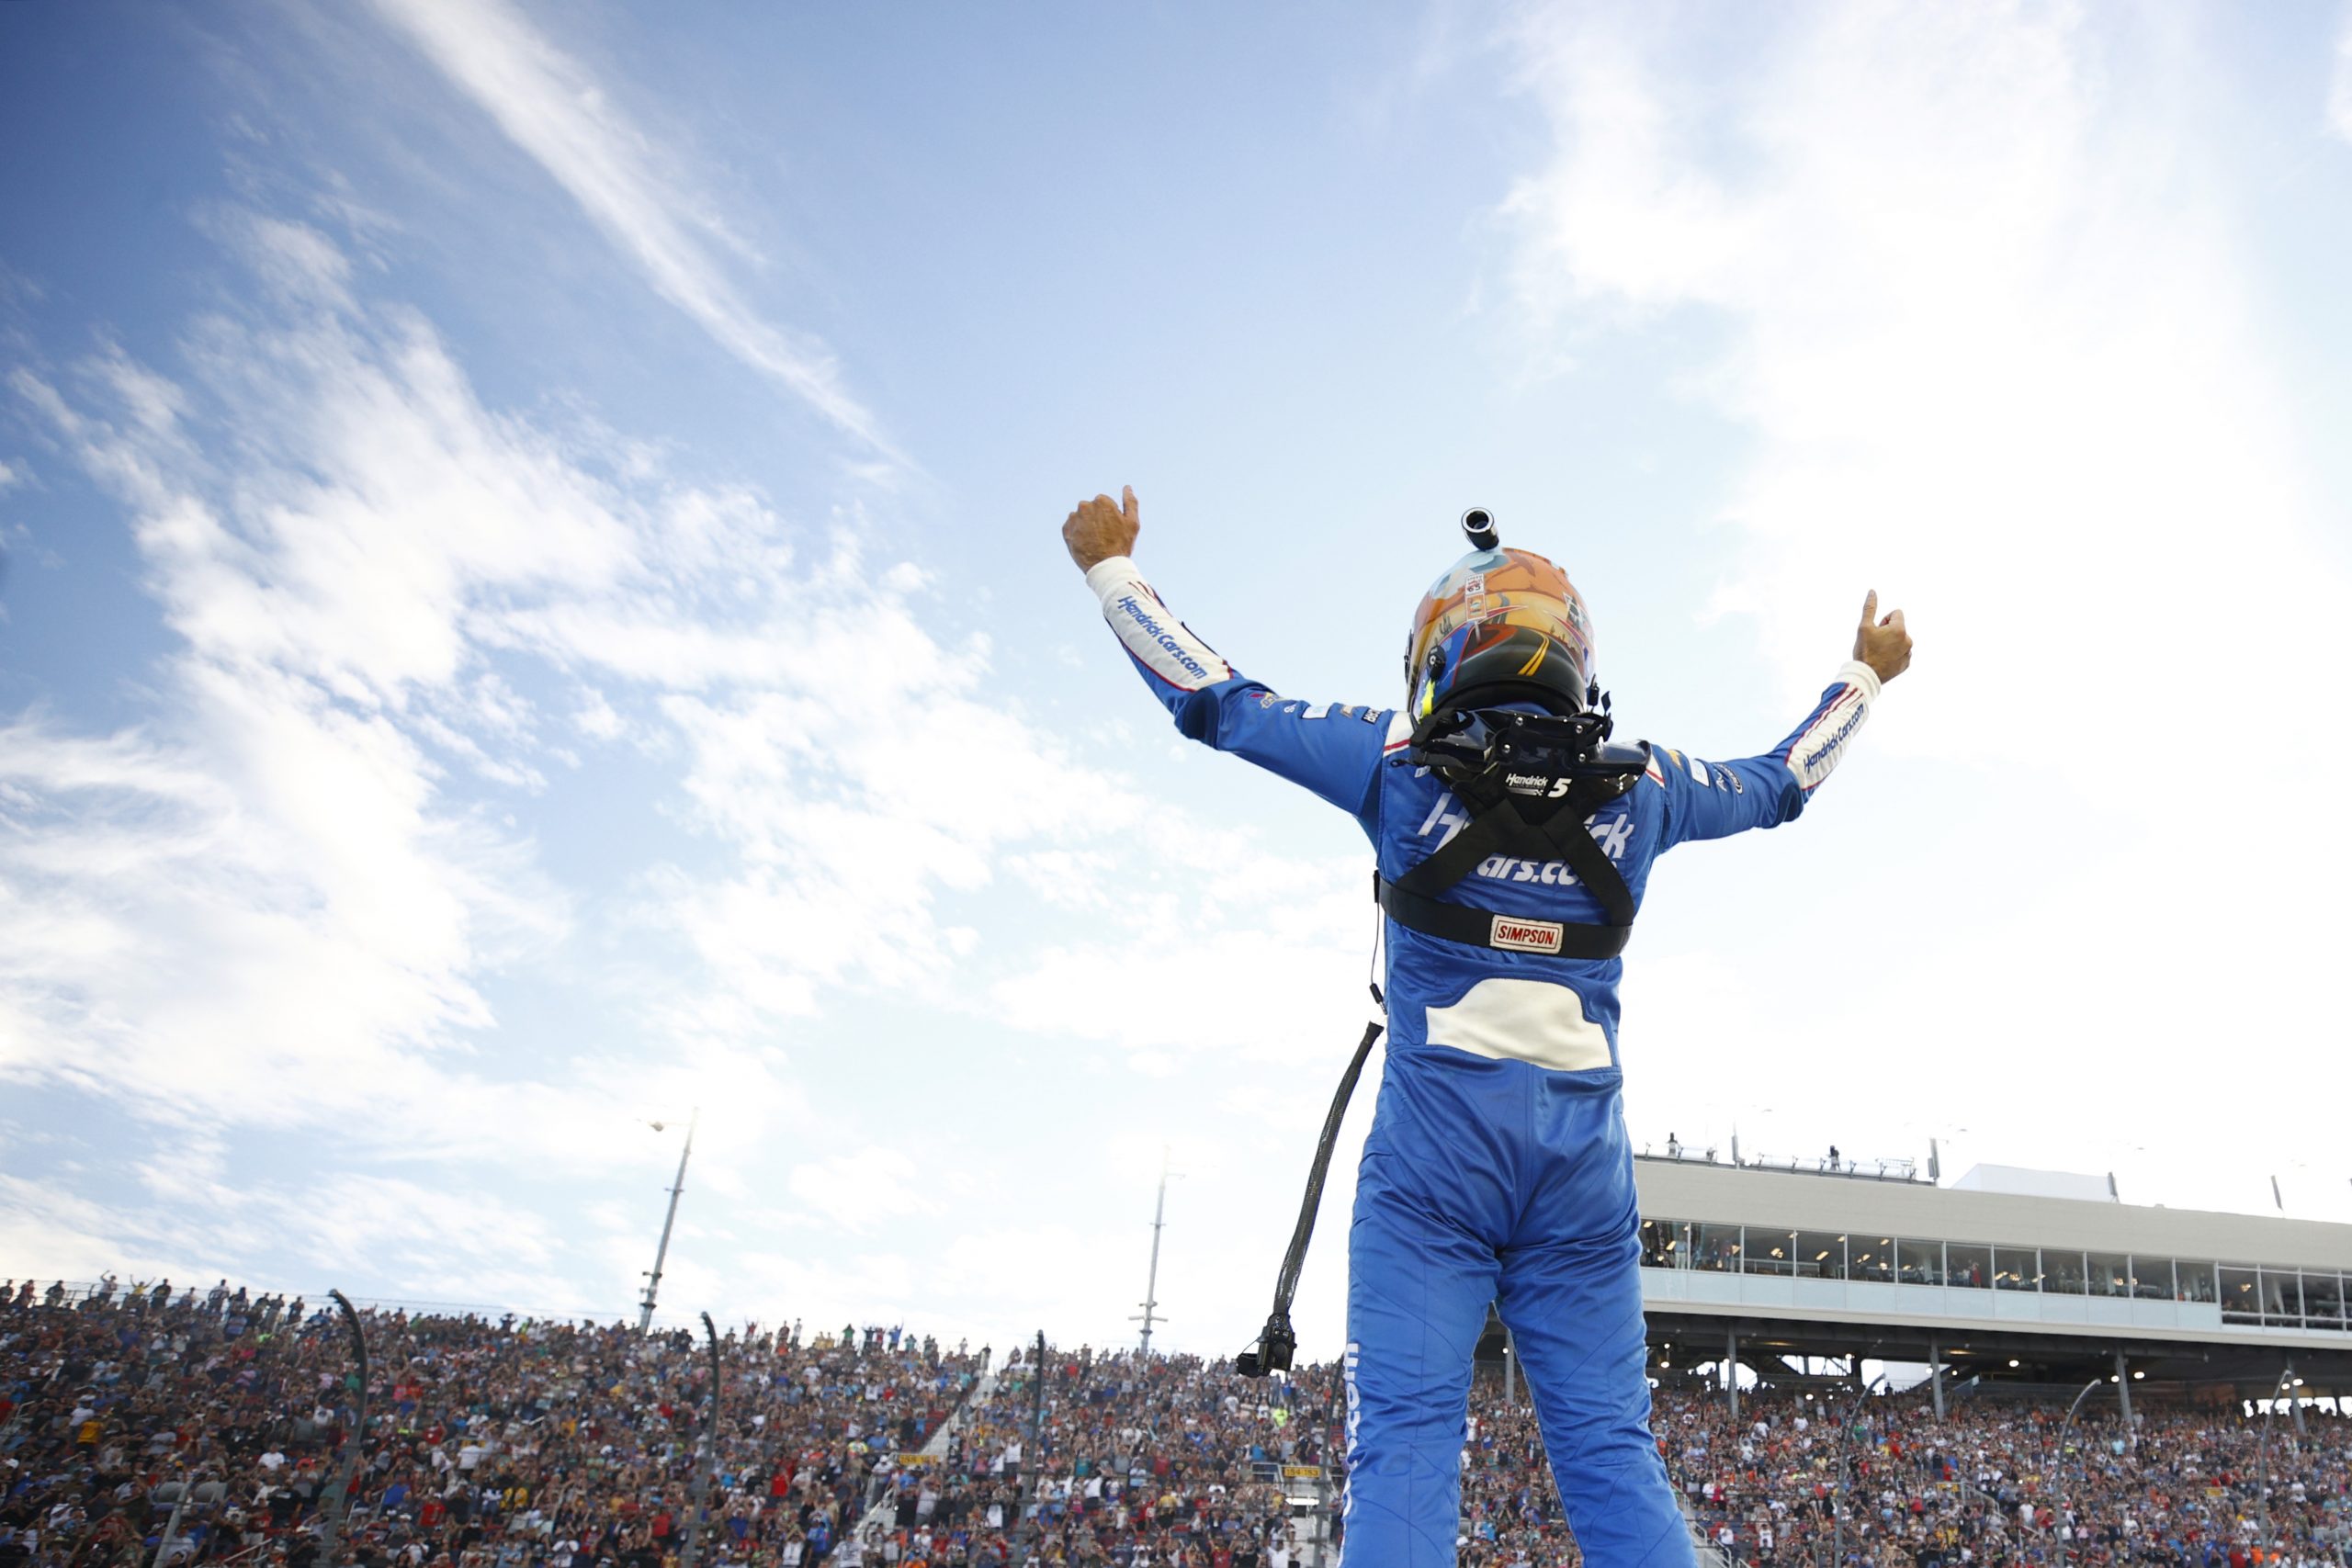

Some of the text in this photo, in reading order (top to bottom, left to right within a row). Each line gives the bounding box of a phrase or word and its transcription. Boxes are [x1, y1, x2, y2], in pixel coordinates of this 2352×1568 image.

[1506, 773, 1572, 797] Hendrick 5
[1498, 925, 1555, 945] SIMPSON
